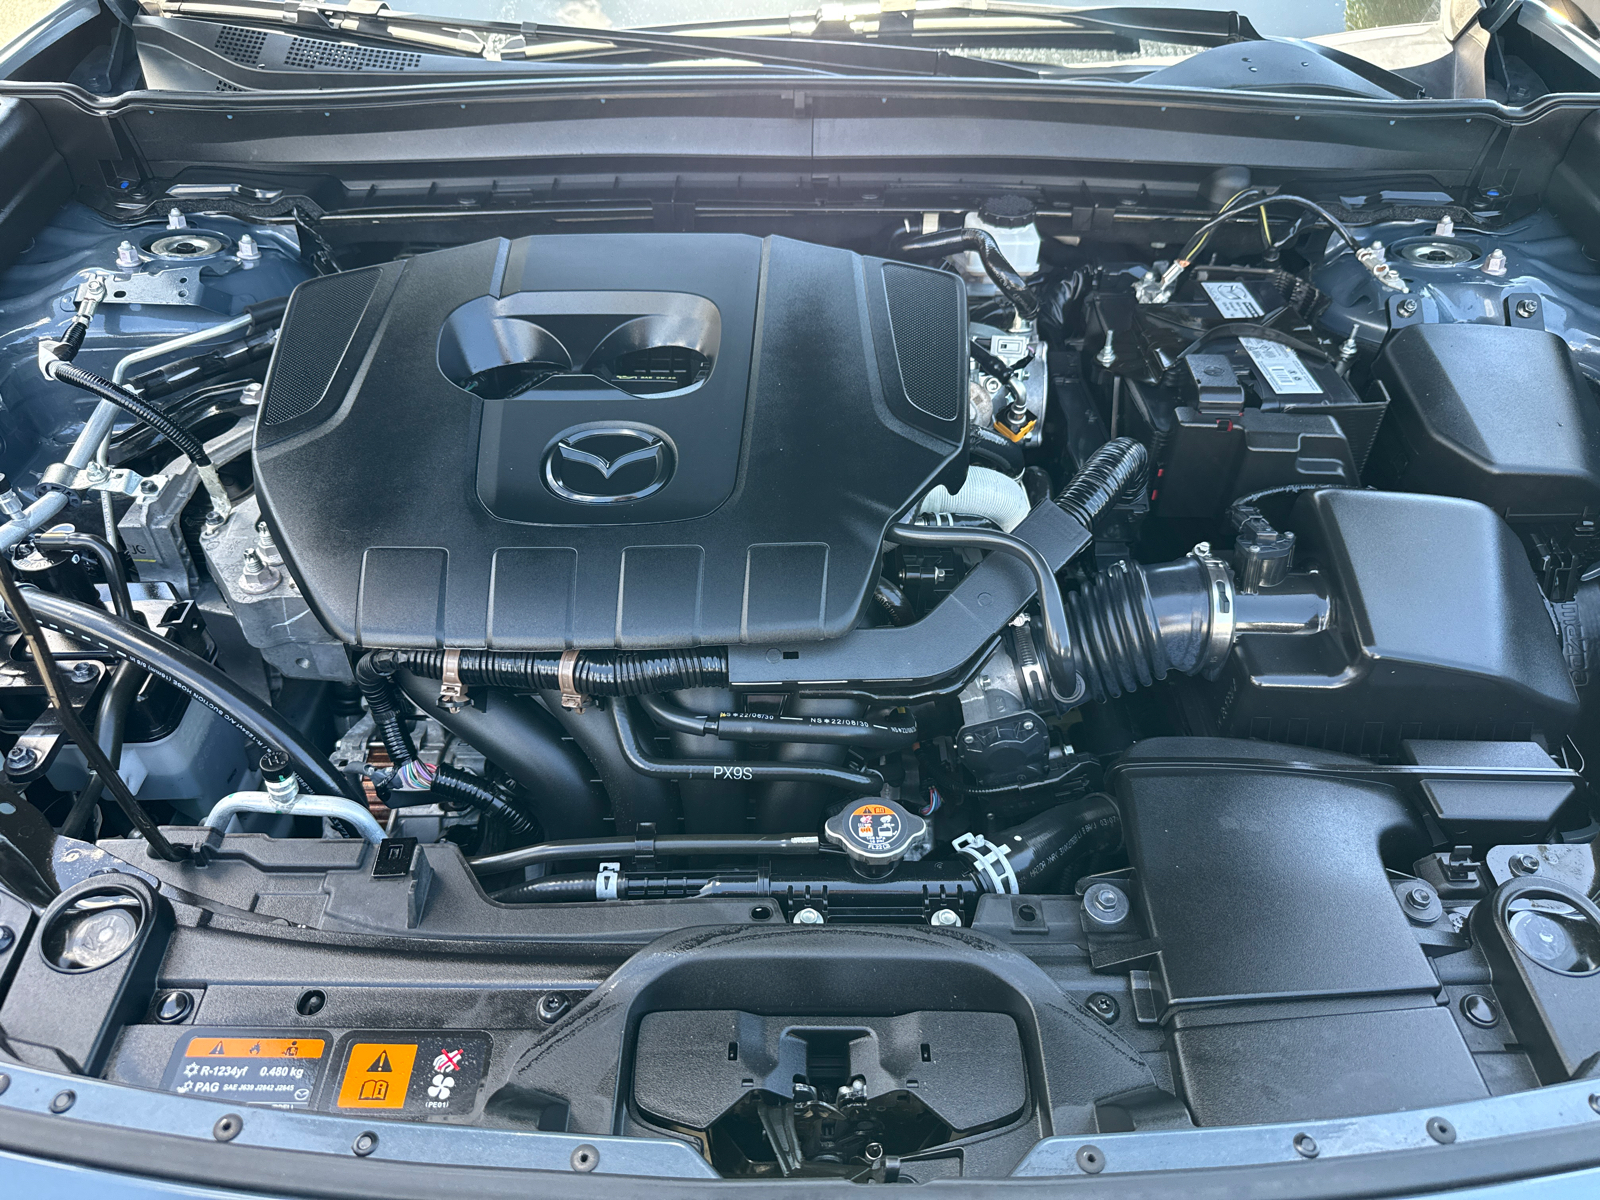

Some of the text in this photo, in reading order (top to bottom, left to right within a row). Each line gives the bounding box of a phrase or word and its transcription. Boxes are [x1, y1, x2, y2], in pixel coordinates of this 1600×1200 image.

[172, 679, 192, 695] HOSE
[192, 692, 224, 716] SUCTION
[713, 766, 753, 780] PX9S
[200, 1065, 304, 1078] R-1234yf 0.480 kg
[194, 1082, 220, 1092] PAG
